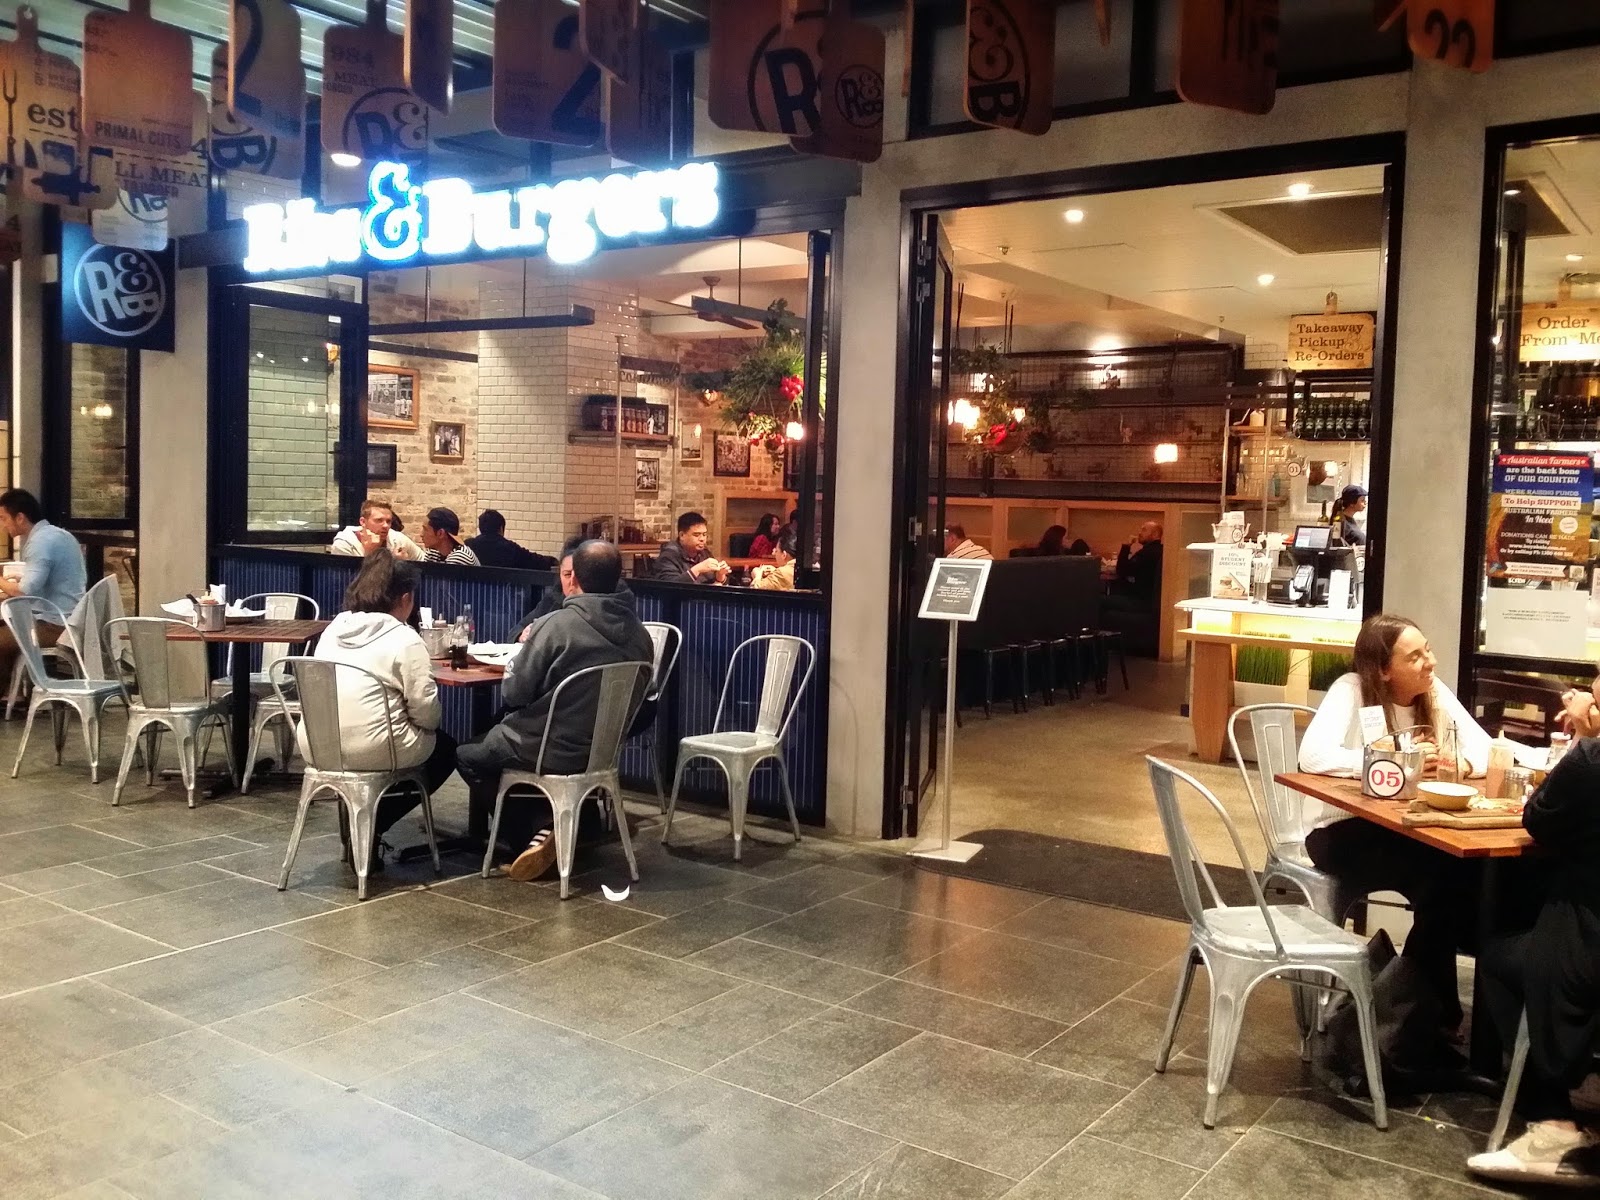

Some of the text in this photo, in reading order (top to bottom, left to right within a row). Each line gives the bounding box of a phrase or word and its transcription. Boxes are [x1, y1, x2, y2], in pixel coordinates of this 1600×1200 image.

[95, 121, 146, 144] PRIMAL
[151, 135, 183, 150] CUTS
[364, 161, 422, 260] &
[83, 250, 160, 323] R&B
[1537, 315, 1590, 330] Order
[1296, 323, 1365, 335] Takeaway
[1298, 337, 1346, 349] Pickup
[1520, 333, 1568, 347] From
[1295, 350, 1365, 362] Re-Orders
[1507, 456, 1581, 465] Australian Farmers
[1521, 466, 1534, 474] the
[1536, 467, 1558, 475] back
[1559, 467, 1581, 476] bone
[1504, 474, 1516, 482] OF
[1518, 475, 1536, 483] OUR
[1505, 497, 1578, 507] To Help SUPPORT
[1371, 769, 1401, 788] 05
